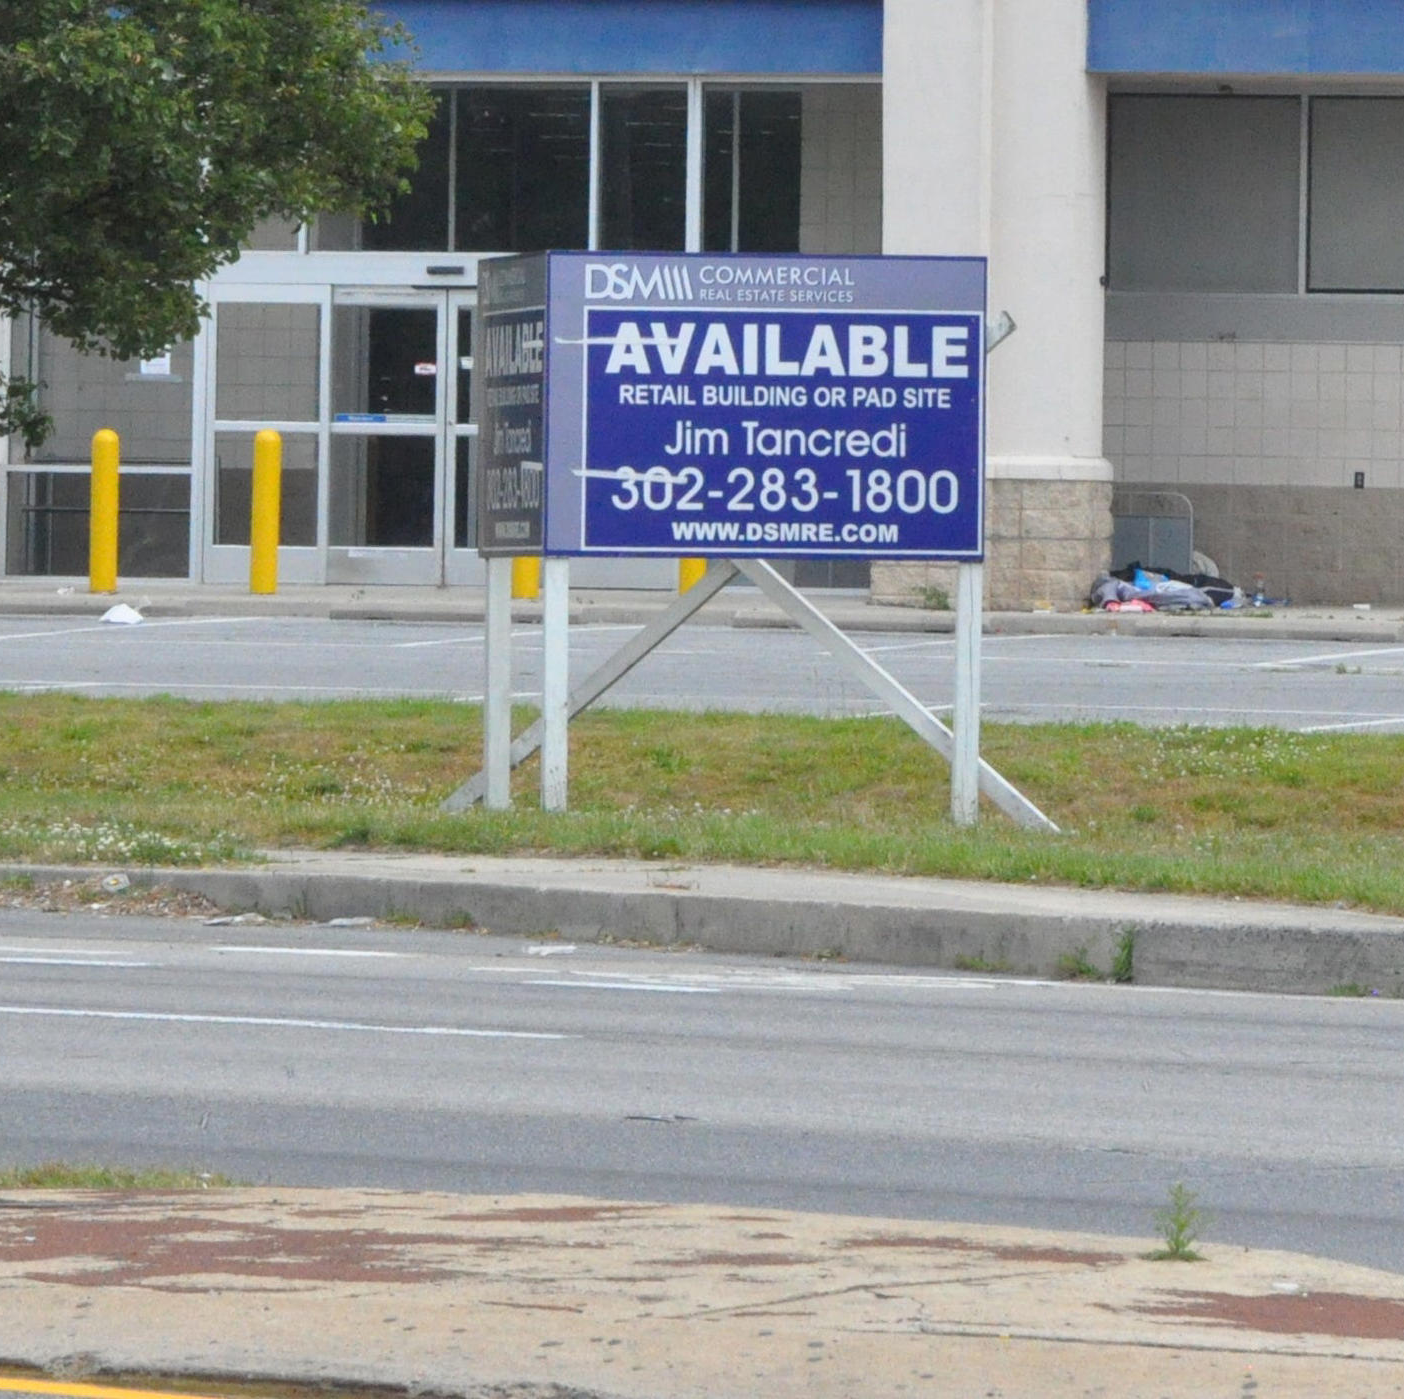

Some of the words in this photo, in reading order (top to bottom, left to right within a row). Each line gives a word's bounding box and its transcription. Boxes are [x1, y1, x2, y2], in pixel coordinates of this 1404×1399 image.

[699, 265, 855, 287] COMMERCIAL
[700, 289, 731, 301] REAL
[737, 290, 785, 303] ESTATE
[790, 290, 853, 303] SERVICES
[604, 321, 970, 379] AVAILABLE
[619, 384, 696, 405] RETAIL
[703, 385, 807, 407] BUILDING
[813, 387, 847, 407] OR
[853, 388, 897, 408] PAD
[903, 388, 952, 409] SITE
[663, 420, 729, 456] Jim
[741, 420, 907, 458] Tancredi
[611, 466, 960, 514] 302-283-1800
[671, 521, 899, 543] WWW.DSMRE.COM
